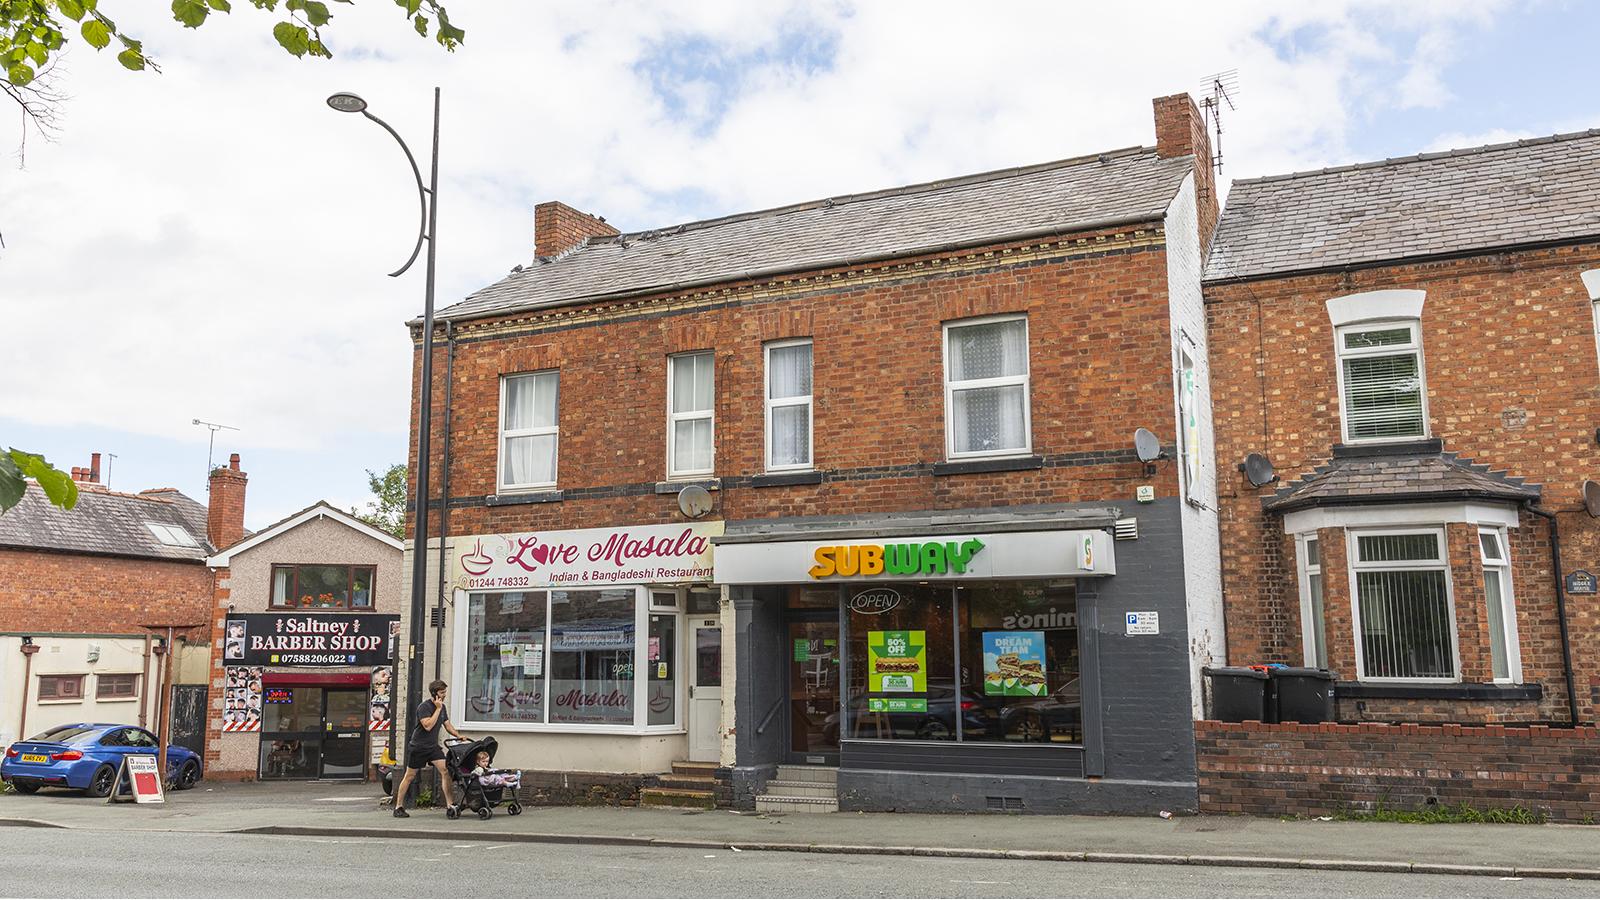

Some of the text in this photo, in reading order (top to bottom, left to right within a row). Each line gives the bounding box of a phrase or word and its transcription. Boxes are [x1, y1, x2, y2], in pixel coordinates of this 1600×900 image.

[587, 528, 710, 567] Masala
[808, 538, 985, 579] SUBWAY
[549, 566, 714, 583] Indian & Bangladeshi Restaurant
[469, 576, 529, 588] 01244 748332
[856, 592, 894, 608] OPEN
[1129, 615, 1136, 624] P
[286, 617, 349, 636] Saltney
[251, 635, 381, 650] BARBER SHOP
[887, 638, 906, 646] 50%
[995, 638, 1032, 647] DREAM
[887, 645, 906, 653] OFF
[1000, 646, 1029, 654] TEAM
[281, 654, 346, 663] 07588206022
[612, 663, 634, 676] open
[556, 689, 629, 711] Masala
